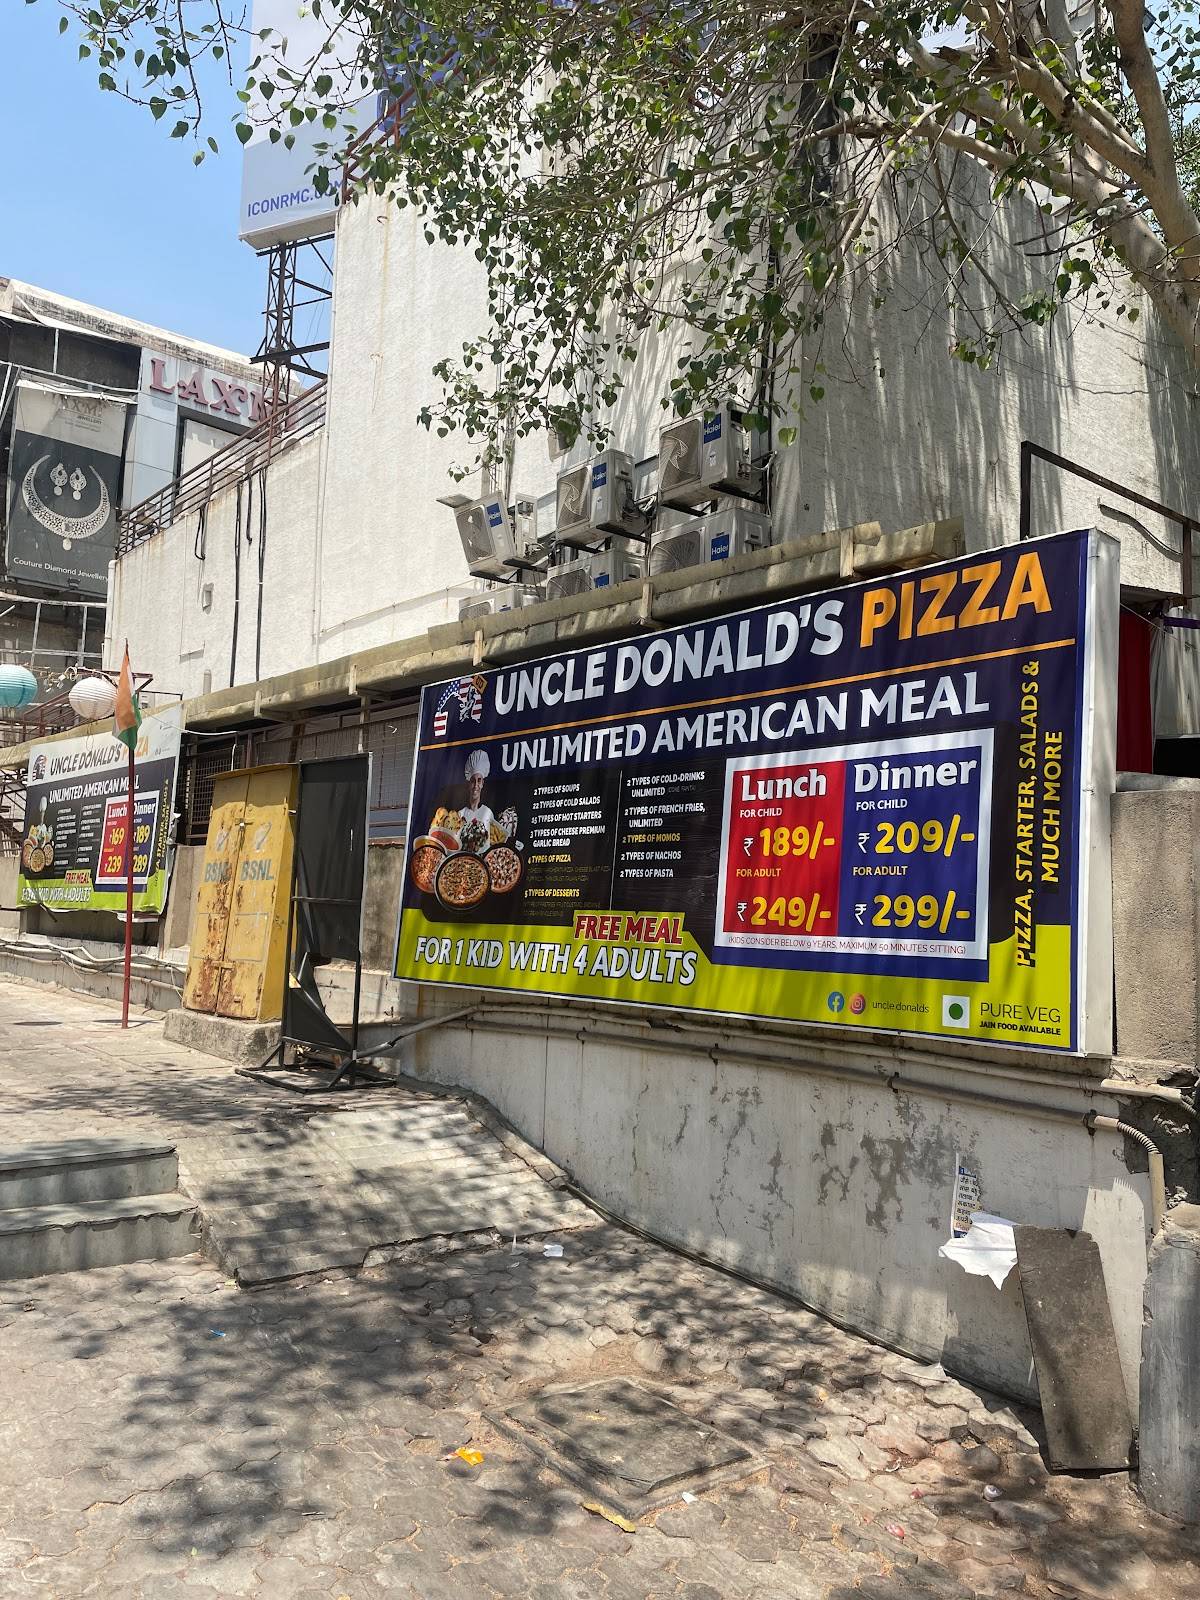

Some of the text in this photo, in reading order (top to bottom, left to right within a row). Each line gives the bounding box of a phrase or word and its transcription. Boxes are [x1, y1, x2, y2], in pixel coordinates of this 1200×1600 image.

[711, 544, 729, 556] Haier
[13, 557, 43, 569] Couture
[44, 562, 77, 576] Diamond
[495, 551, 1052, 715] UNCLE DONALD'S PIZZA
[501, 672, 990, 772] UNLIMITED AMERICAN MEAL
[50, 753, 80, 776] UNCLE
[632, 776, 651, 786] TYPES
[651, 775, 660, 784] OF
[660, 771, 705, 784] COLD-DRINKS
[854, 760, 978, 793] Dinner
[49, 785, 83, 804] UNLIMITED
[83, 778, 120, 798] AMERICAN
[538, 786, 554, 795] TYPES
[554, 785, 562, 793] OF
[562, 783, 580, 792] SOUPS
[741, 768, 827, 801] Lunch
[631, 787, 665, 798] UNLIMITED
[540, 800, 556, 809] TYPES
[556, 799, 564, 807] OF
[564, 798, 579, 807] COLD
[579, 796, 601, 806] SALADS
[629, 806, 648, 816] TYPES
[649, 805, 658, 814] OF
[658, 804, 684, 814] FRENCH
[856, 799, 908, 811] FOR CHILD
[1041, 731, 1063, 883] MUCH MORE
[108, 804, 128, 819] Lunch
[538, 814, 554, 823] TYPES
[554, 814, 562, 822] OF
[562, 813, 574, 821] HOT
[574, 811, 602, 821] STARTERS
[740, 808, 782, 818] FOR CHILD
[1014, 661, 1039, 967] PIZZA, STARTER, SALADS &
[629, 818, 663, 828] UNLIMITED
[136, 825, 151, 844] 189
[534, 829, 550, 837] TYPES
[550, 828, 558, 836] OF
[558, 826, 579, 836] CHEESE
[579, 825, 606, 835] PREMIUM
[627, 834, 646, 843] TYPES
[647, 834, 655, 842] OF
[656, 833, 681, 842] MOMOS
[532, 838, 571, 848] GARLIC BREAD
[532, 855, 548, 863] TYPES
[548, 854, 556, 863] OF
[556, 854, 572, 863] PIZZA
[626, 852, 645, 860] TYPES
[645, 852, 654, 860] OF
[654, 851, 682, 860] NACHOS
[107, 856, 122, 873] 239
[241, 859, 274, 881] BSNL
[853, 865, 908, 876] FOR ADULT
[624, 869, 644, 877] TYPES
[644, 869, 653, 877] OF
[654, 869, 674, 878] PASTA
[736, 868, 781, 878] FOR ADULT
[528, 889, 545, 897] TYPES
[545, 889, 553, 897] OF
[552, 888, 580, 897] DESSERTS
[574, 914, 684, 946] FREE MEAL
[745, 937, 779, 946] CONSIDER
[780, 938, 805, 947] BELOW
[839, 941, 877, 950] MAXIMUM
[880, 944, 888, 952] 50
[890, 943, 928, 953] MINUTES
[414, 936, 698, 986] FOR 1 KID WITH 4 ADULTS
[980, 1002, 1061, 1023] PURE VEG
[979, 1021, 1061, 1036] JAIN FOOD AVAILABLE
